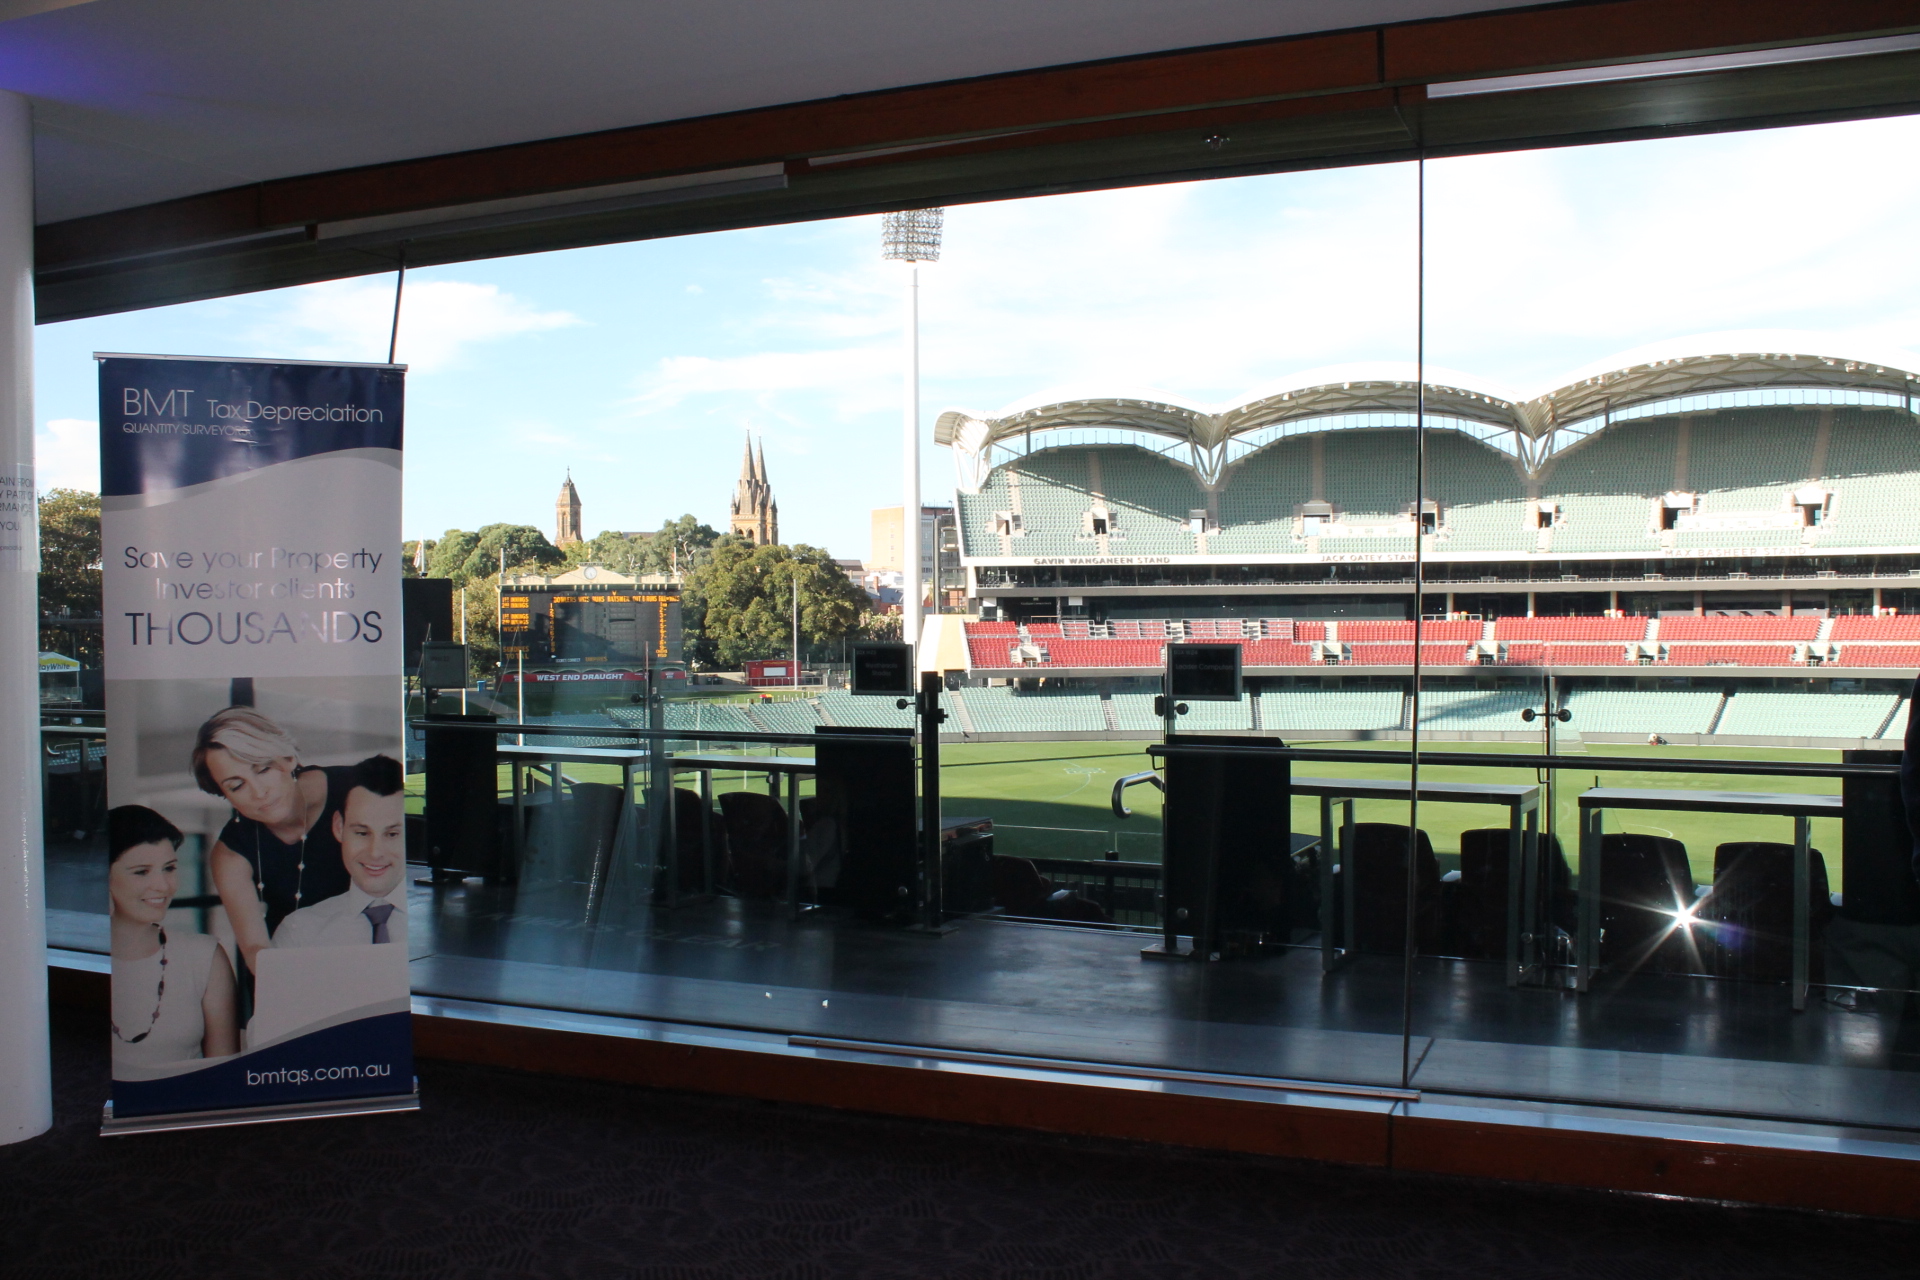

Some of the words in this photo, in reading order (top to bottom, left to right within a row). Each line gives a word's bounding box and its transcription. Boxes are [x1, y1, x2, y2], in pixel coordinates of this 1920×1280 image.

[123, 388, 195, 417] BMT
[206, 399, 243, 419] Tax
[246, 401, 383, 424] Depreciation
[122, 422, 180, 434] QUANTITY
[182, 423, 250, 436] SURVEYORS
[124, 546, 194, 569] Save
[202, 551, 263, 573] your
[271, 547, 382, 573] Property
[1068, 557, 1134, 565] WANGANEEN
[1350, 554, 1383, 562] OATEY
[1664, 549, 1691, 557] MAX
[1699, 547, 1758, 557] BASHEER
[1761, 546, 1807, 555] STAND
[155, 577, 263, 600] Investor
[270, 577, 355, 600] clients
[124, 610, 383, 646] THOUSANDS
[247, 1063, 391, 1086] bmtqs.com.au
